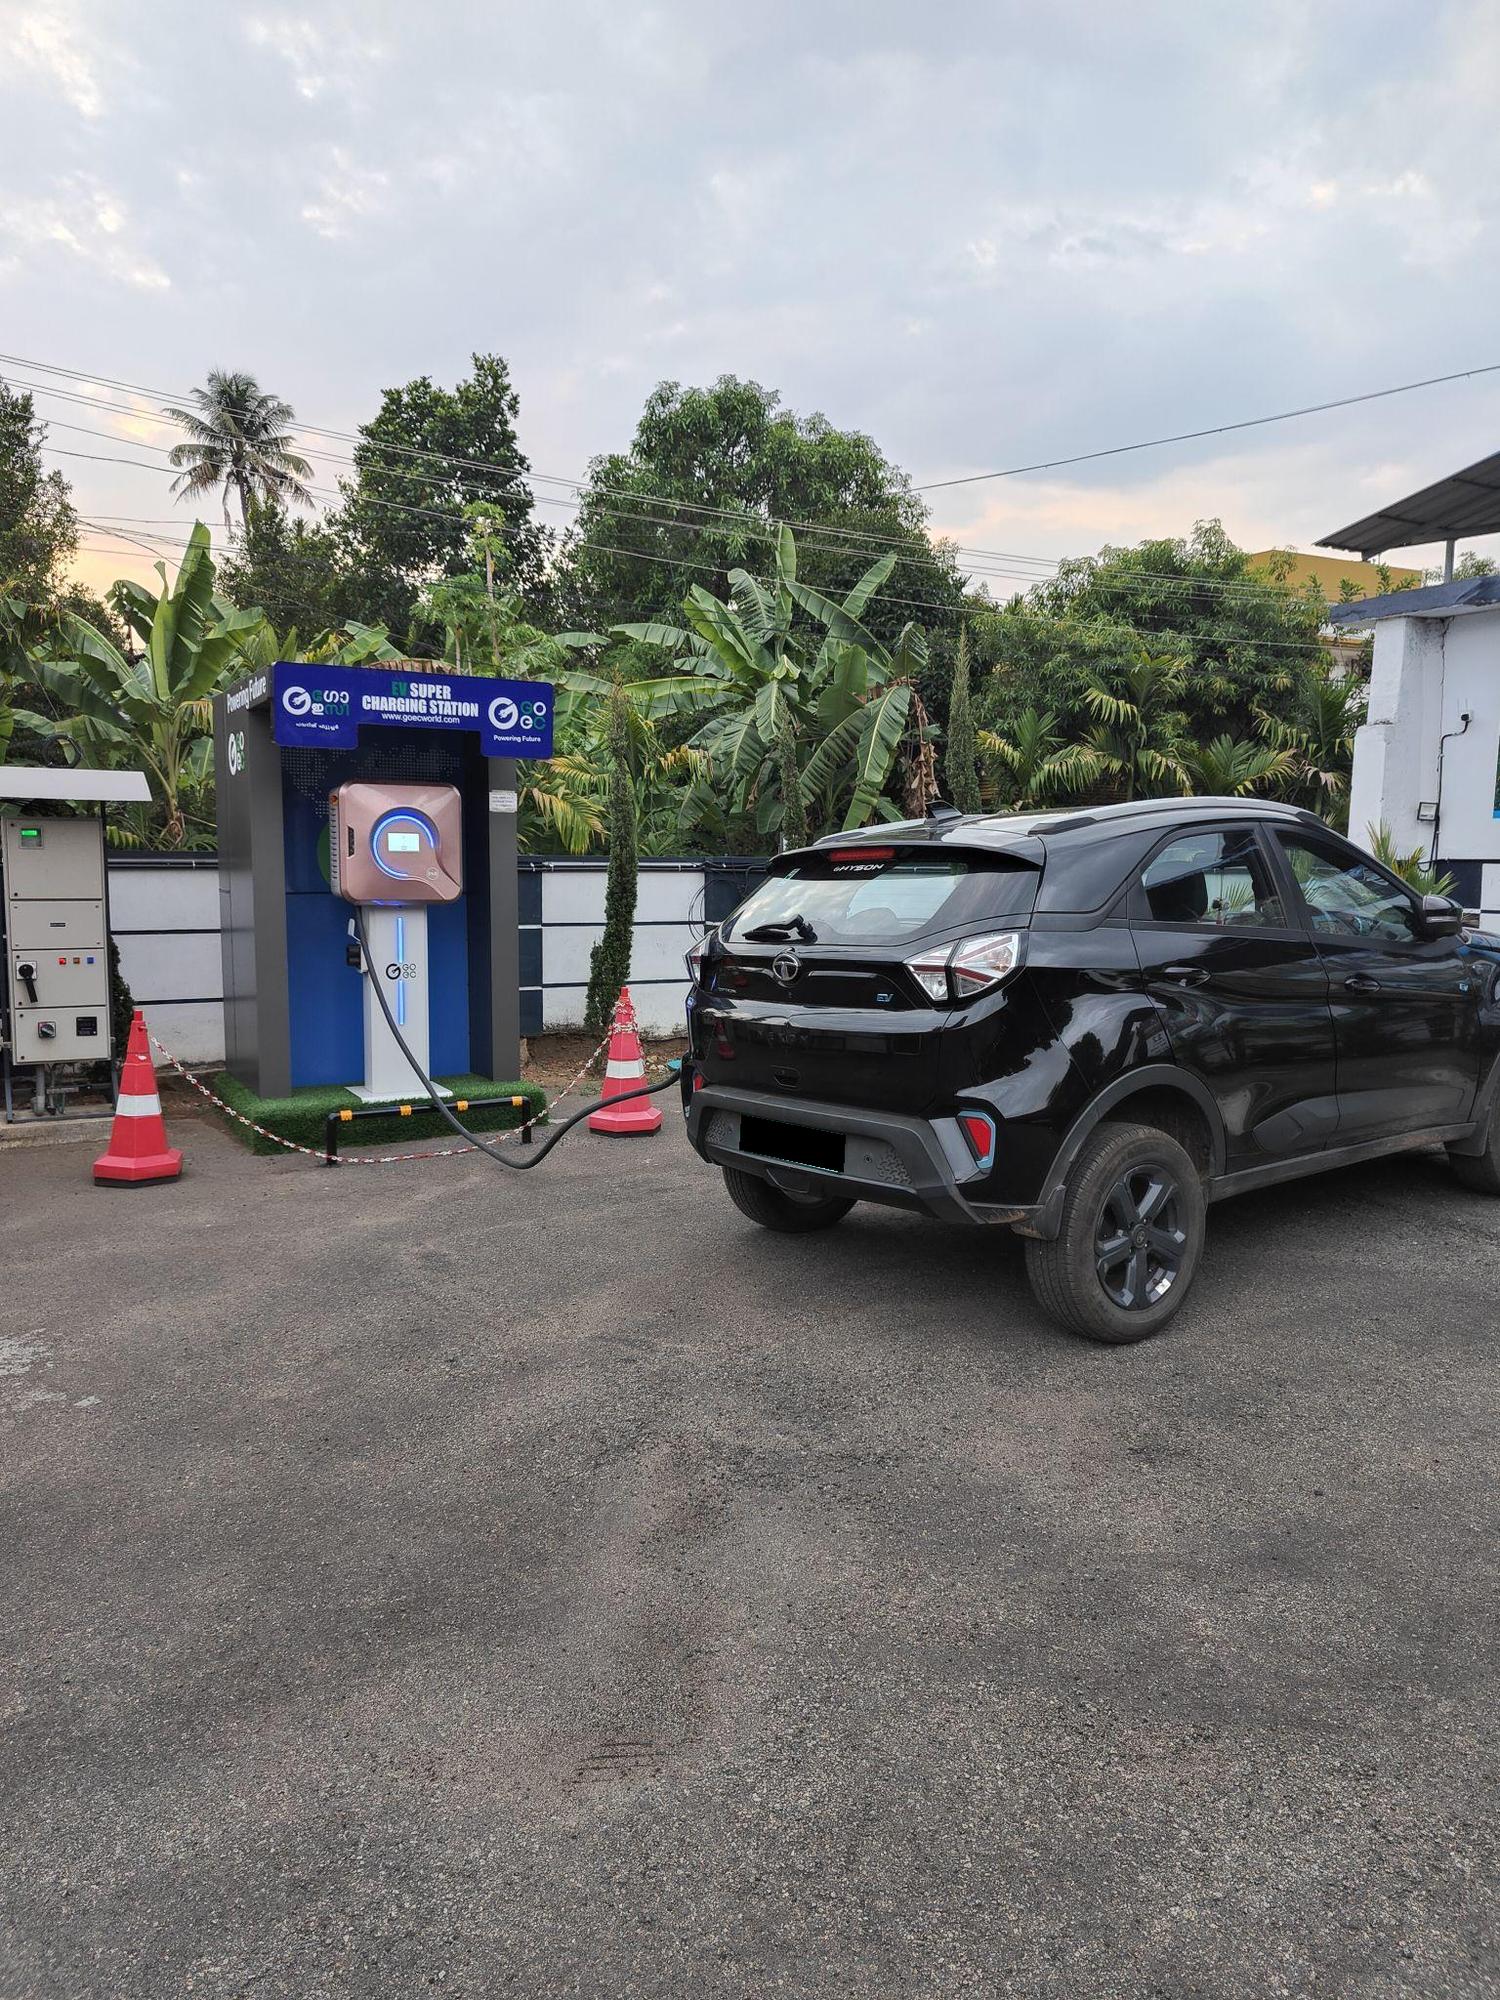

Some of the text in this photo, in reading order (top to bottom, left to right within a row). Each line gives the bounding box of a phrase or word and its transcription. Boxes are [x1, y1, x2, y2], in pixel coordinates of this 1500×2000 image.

[226, 676, 267, 714] Powering Future
[391, 681, 452, 700] EV SUPER
[361, 695, 479, 718] CHARGING STATION
[381, 713, 461, 724] www.goecworld.com
[493, 734, 522, 743] Powering
[876, 993, 894, 1003] EV
